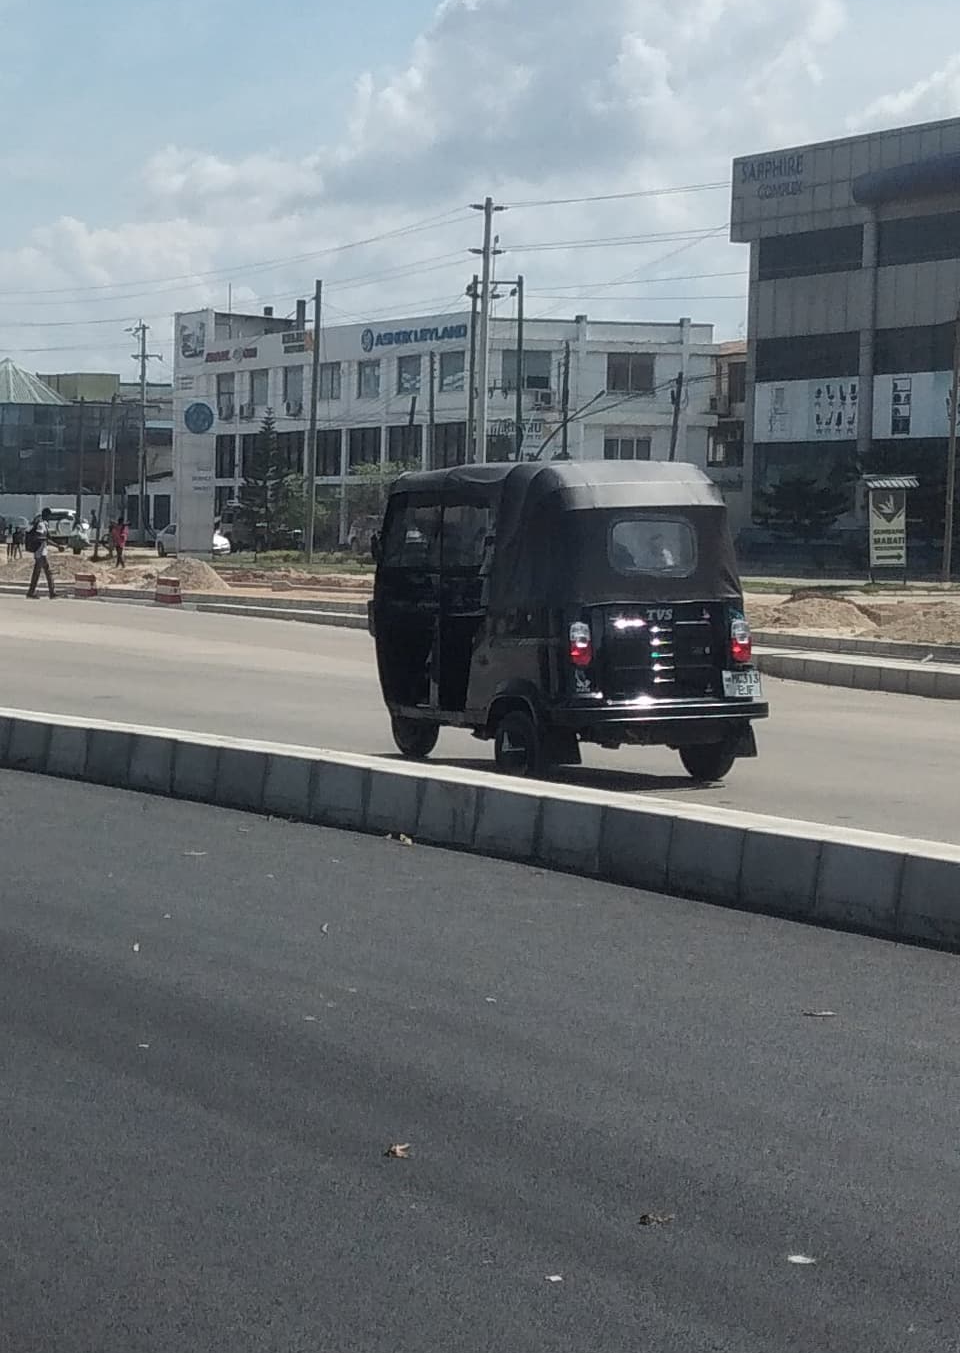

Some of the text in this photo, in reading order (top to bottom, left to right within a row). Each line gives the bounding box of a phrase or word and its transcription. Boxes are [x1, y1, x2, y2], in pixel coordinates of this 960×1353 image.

[741, 154, 804, 184] SAPPHIRE
[757, 181, 803, 200] COMPLEX
[375, 324, 468, 347] ASHOK LEYLAND
[873, 536, 905, 545] MABATI
[646, 608, 674, 621] TVS
